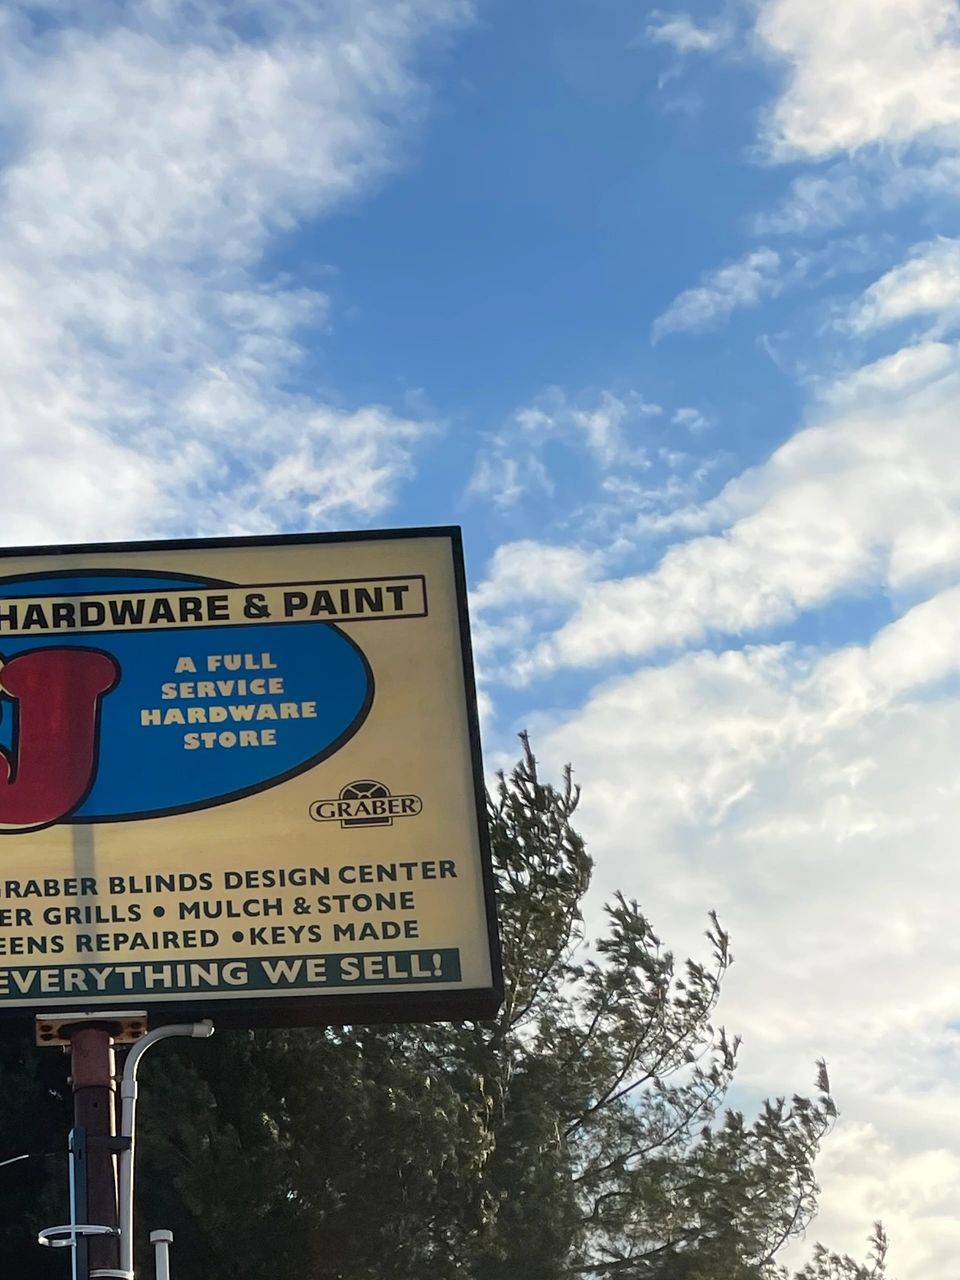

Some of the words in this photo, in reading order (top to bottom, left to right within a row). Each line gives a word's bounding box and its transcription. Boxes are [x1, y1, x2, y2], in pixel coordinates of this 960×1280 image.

[243, 593, 269, 620] &
[283, 585, 410, 617] PAINT
[174, 656, 197, 673] A
[207, 652, 278, 671] FULL
[161, 677, 285, 700] SERVICE
[140, 701, 318, 726] HARDWARE
[183, 729, 278, 750] STORE
[315, 796, 420, 820] GRABER
[109, 873, 213, 895] BLINDS
[224, 866, 330, 890] DESIGN
[338, 860, 458, 884] CENTER
[43, 905, 142, 925] GRILLS
[178, 898, 283, 920] MULCH
[293, 897, 312, 916] &
[318, 891, 416, 914] STONE
[76, 929, 220, 954] REPAIRED
[249, 924, 322, 945] KEYS
[333, 920, 420, 941] MADE
[261, 956, 328, 984] WE
[339, 953, 443, 980] SELL!
